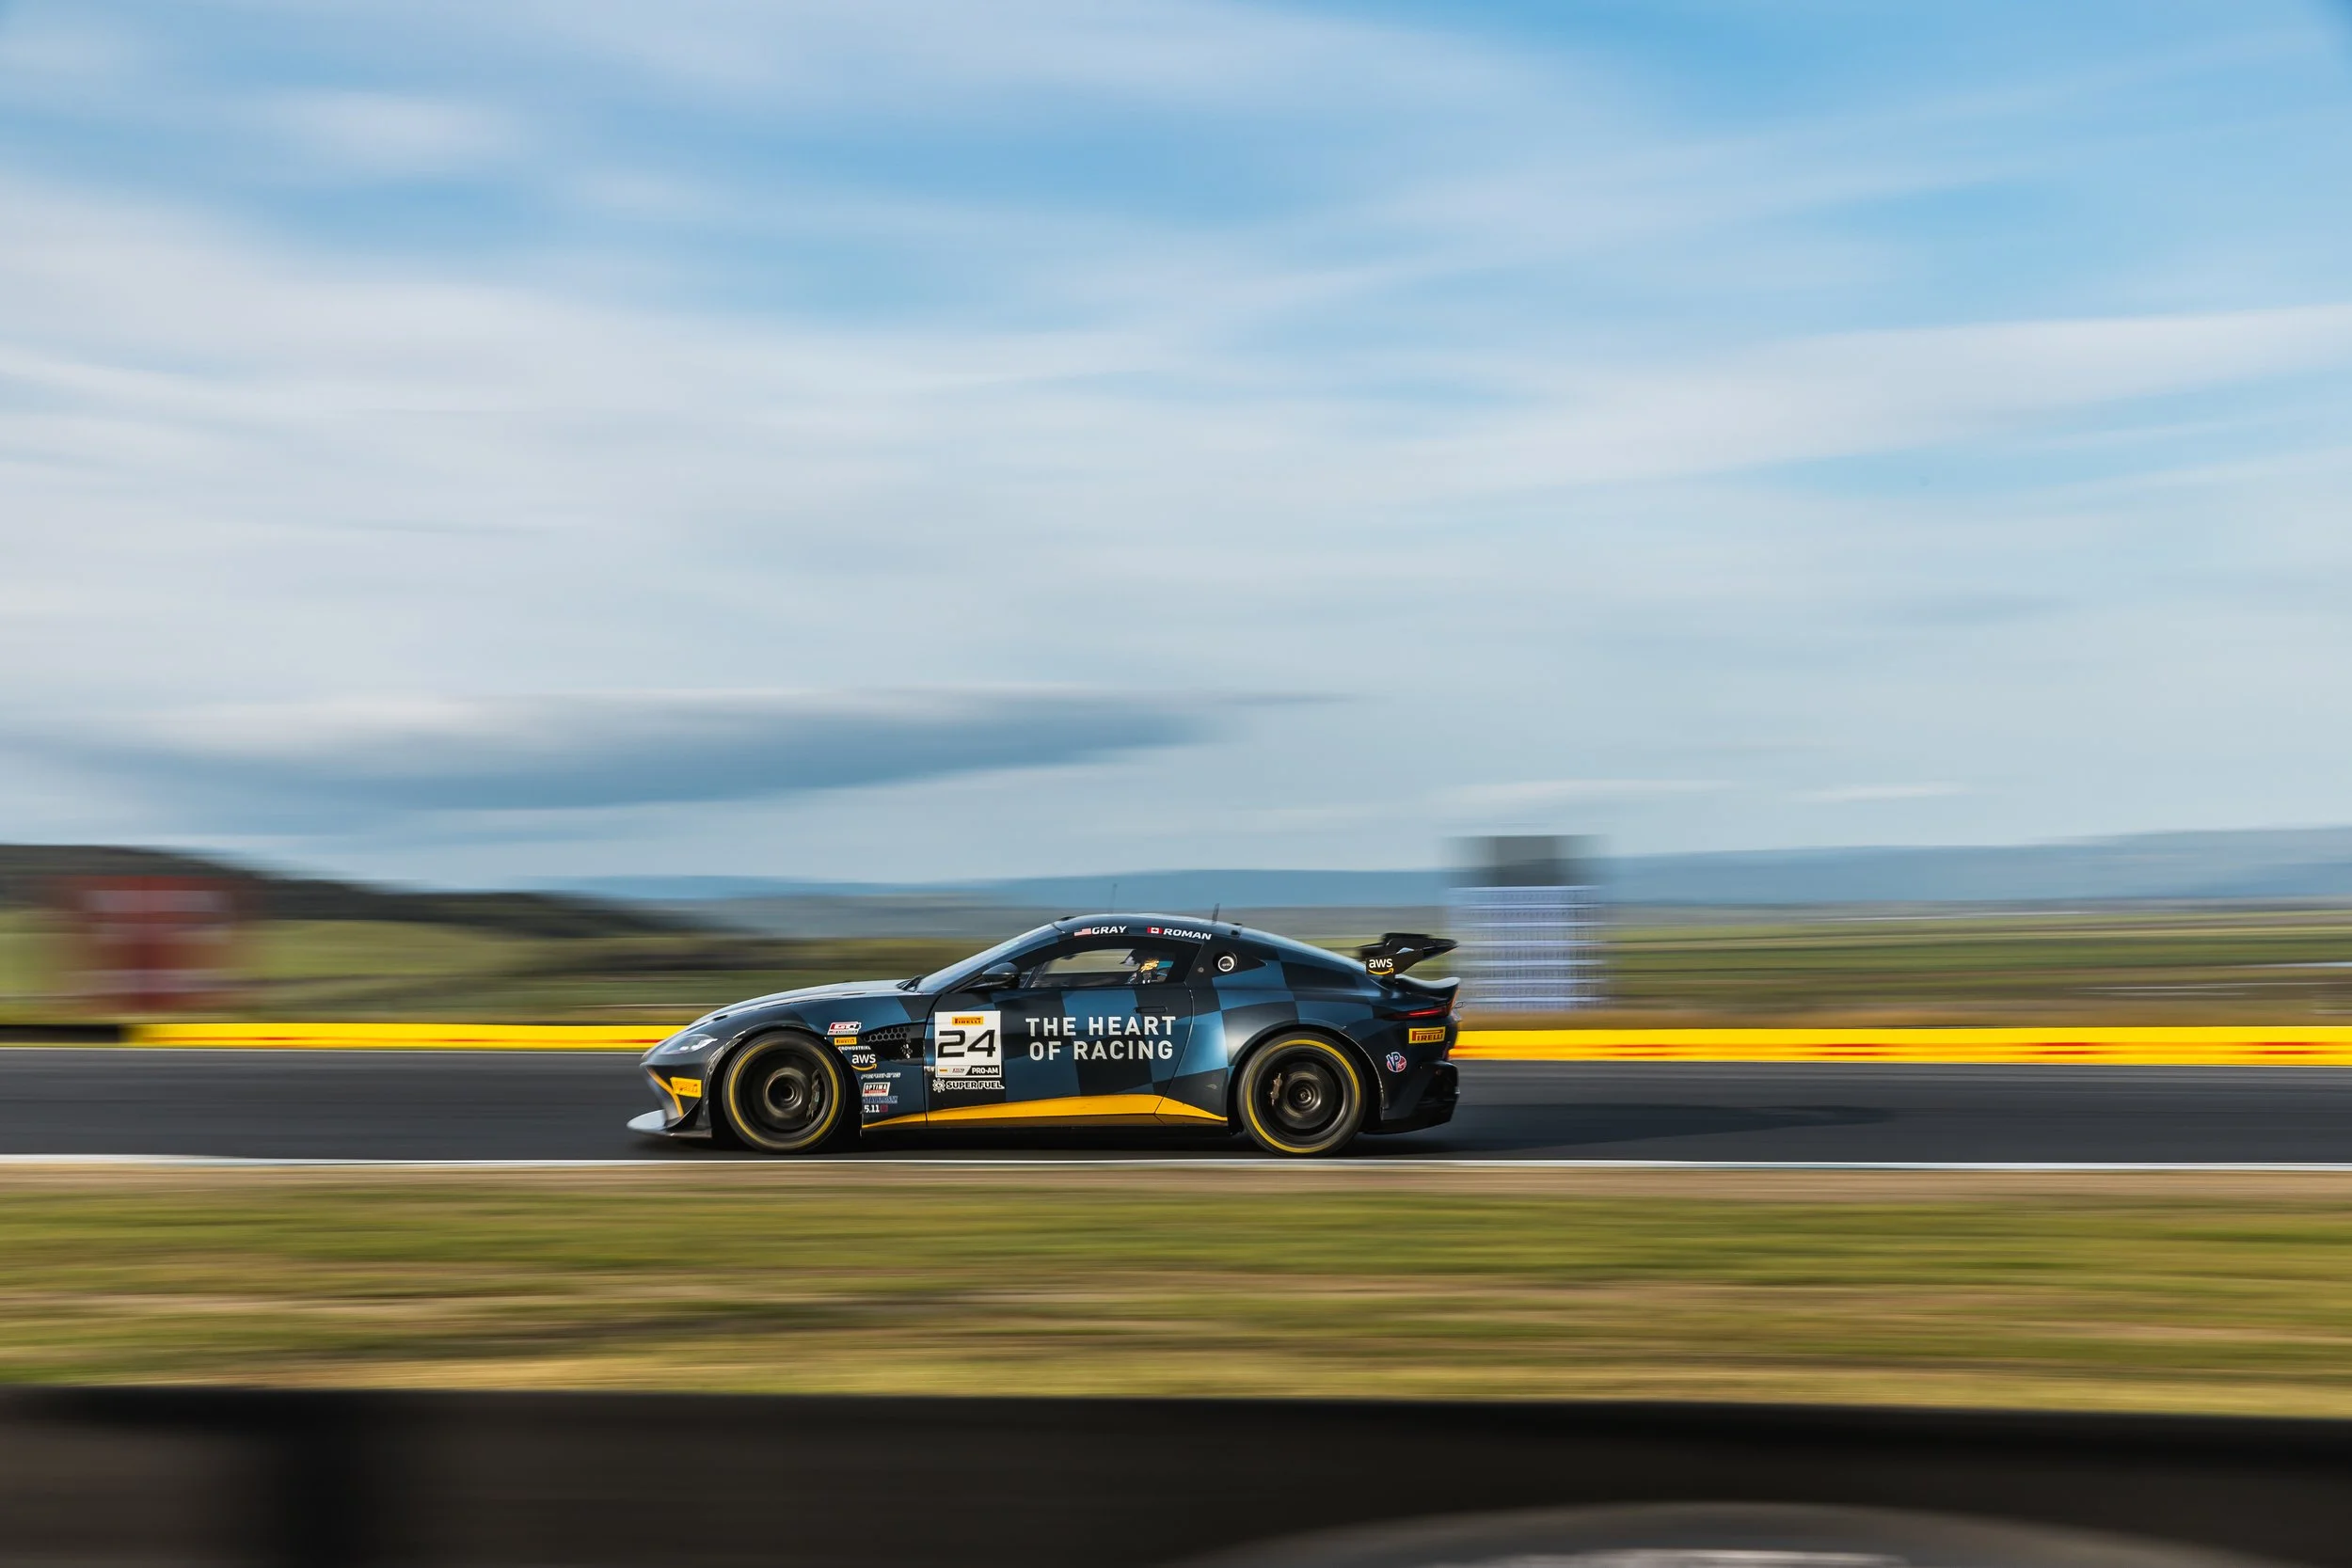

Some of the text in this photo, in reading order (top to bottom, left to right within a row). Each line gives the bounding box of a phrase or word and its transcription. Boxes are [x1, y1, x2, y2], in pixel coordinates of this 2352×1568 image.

[1091, 926, 1212, 941] GRAY ROMAN
[1369, 958, 1393, 968] aws
[1025, 1016, 1176, 1037] THE HEART
[1411, 1030, 1444, 1041] PIRELLI
[937, 1029, 996, 1058] 24
[1029, 1039, 1173, 1061] OF RACING
[851, 1053, 876, 1064] aws
[946, 1081, 977, 1090] SUPER
[864, 1104, 880, 1113] 5.11
